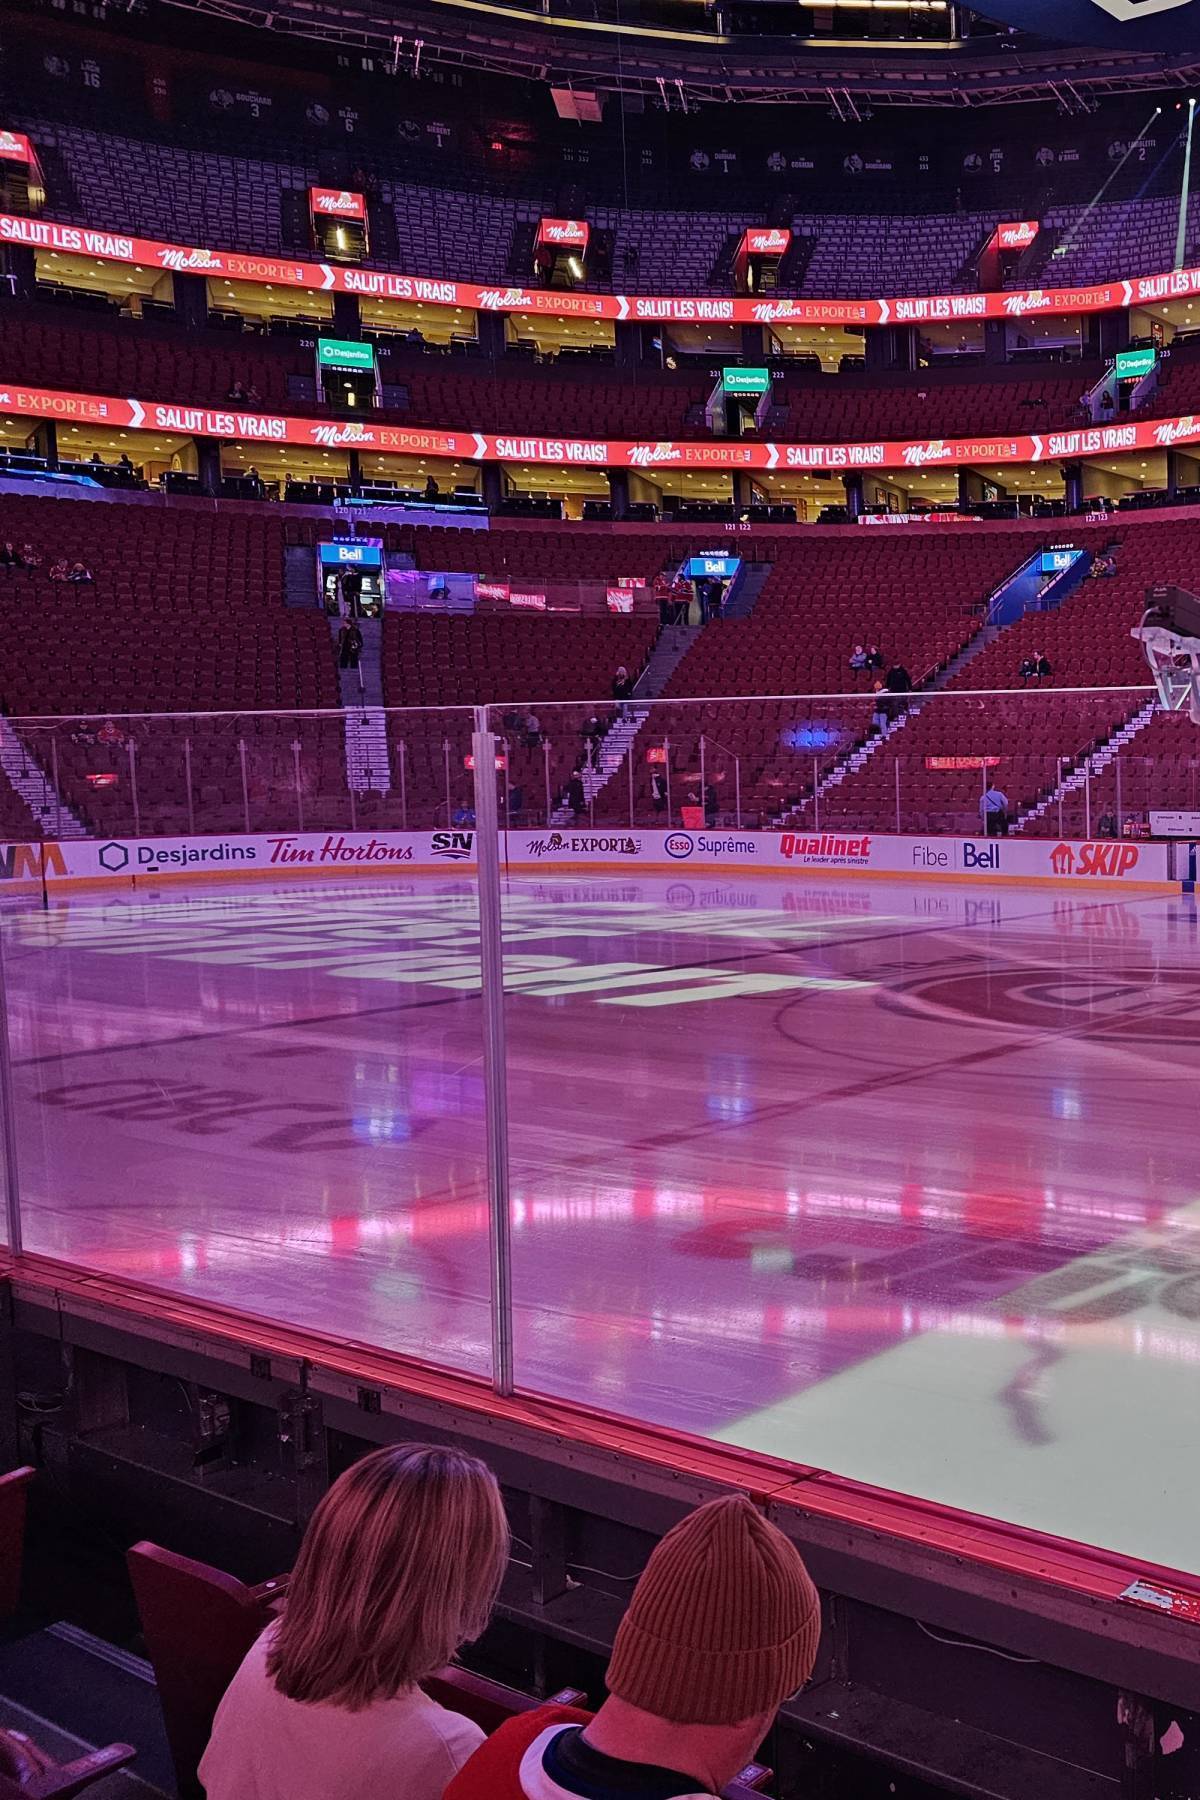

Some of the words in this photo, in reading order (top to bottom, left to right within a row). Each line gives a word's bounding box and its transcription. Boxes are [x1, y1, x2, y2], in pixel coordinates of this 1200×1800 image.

[317, 194, 359, 208] Molson
[0, 218, 49, 243] SALUT
[53, 227, 81, 249] LES
[84, 233, 133, 258] VRAIS!
[158, 249, 222, 270] Molson
[228, 260, 285, 279] EXPORT
[344, 271, 385, 292] SALUT
[388, 278, 412, 296] LES
[414, 281, 456, 302] VRAIS!
[1139, 276, 1169, 298] SALUT
[1171, 271, 1189, 293] LES
[478, 289, 532, 310] Molson
[535, 296, 587, 312] EXPORT
[637, 300, 672, 316] SALUT
[674, 301, 694, 317] LES
[696, 302, 733, 318] VRAIS!
[752, 300, 801, 322] Molson
[806, 307, 851, 318] EXPORT
[896, 300, 928, 318] SALUT
[930, 298, 949, 317] LES
[951, 297, 985, 315] VRAIS!
[1003, 290, 1050, 315] Molson
[1055, 293, 1099, 306] EXPORT
[16, 394, 87, 415] EXPORT
[156, 407, 203, 430] SALUT
[207, 414, 234, 434] LES
[237, 416, 286, 438] VRAIS!
[1153, 416, 1200, 445] Molson
[311, 423, 374, 446] Molson
[381, 432, 440, 451] EXPORT
[1049, 434, 1080, 455] SALUT
[1082, 432, 1100, 451] LES
[1102, 427, 1136, 448] VRAIS!
[496, 439, 536, 458] SALUT
[539, 441, 563, 460] LES
[565, 443, 607, 461] VRAIS!
[627, 443, 681, 466] Molson
[686, 449, 735, 461] EXPORT
[787, 448, 823, 465] SALUT
[826, 448, 846, 465] LES
[848, 446, 883, 464] VRAIS!
[902, 441, 952, 466] Molson
[956, 444, 1003, 457] EXPORT
[338, 547, 362, 561] Bell
[705, 559, 724, 573] Bell
[266, 837, 315, 863] Tim
[319, 836, 414, 862] Hortons
[431, 832, 474, 850] SN
[526, 839, 570, 857] Molson
[571, 838, 628, 853] EXPORT
[669, 838, 690, 850] Esso
[697, 836, 756, 856] Suprême
[780, 833, 872, 859] Qualinet
[138, 843, 257, 866] Desjardins
[913, 845, 948, 867] Fibe
[963, 842, 1000, 869] Bell
[1075, 843, 1139, 877] SKIP
